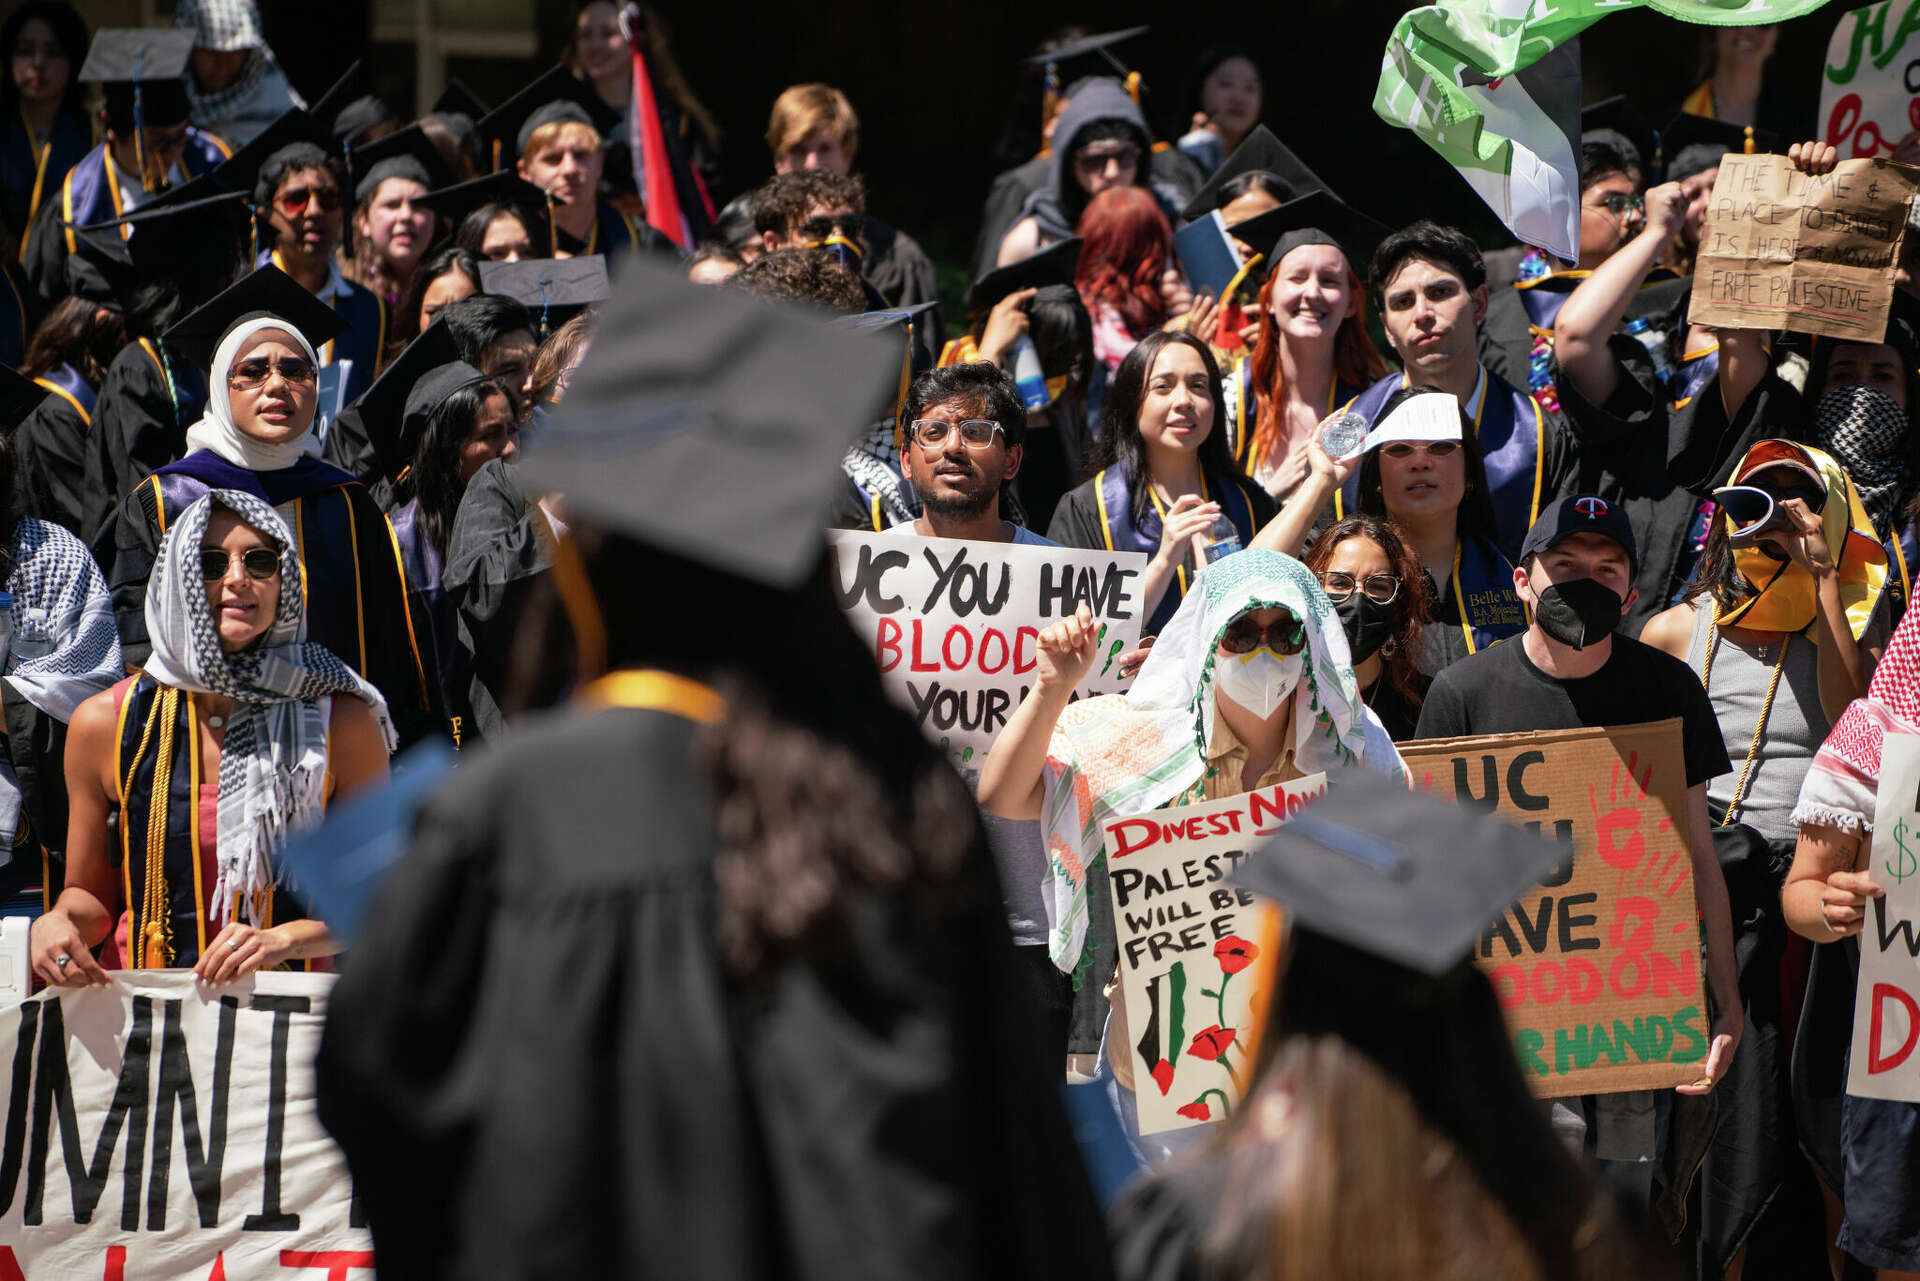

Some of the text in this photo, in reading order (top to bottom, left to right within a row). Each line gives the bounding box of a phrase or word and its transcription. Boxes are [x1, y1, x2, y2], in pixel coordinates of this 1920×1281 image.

[1727, 162, 1775, 192] THE
[1784, 167, 1856, 200] TIME
[1717, 199, 1788, 225] PLACE
[1800, 205, 1824, 230] TO
[1714, 233, 1739, 255] IS
[1756, 238, 1805, 260] HERE
[1711, 270, 1870, 313] FREE PALESTINE
[829, 544, 1138, 619] UC YOU HAVE
[876, 617, 1037, 674] BLOOD
[907, 681, 1007, 733] YOUR
[1451, 750, 1549, 814] UC
[1106, 810, 1245, 859] DIVEST
[1125, 888, 1254, 934] WILL BE
[1474, 892, 1600, 959] AVE
[1125, 914, 1236, 969] FREE
[1489, 950, 1697, 1011] OOD ON
[1554, 1005, 1708, 1076] HANDS
